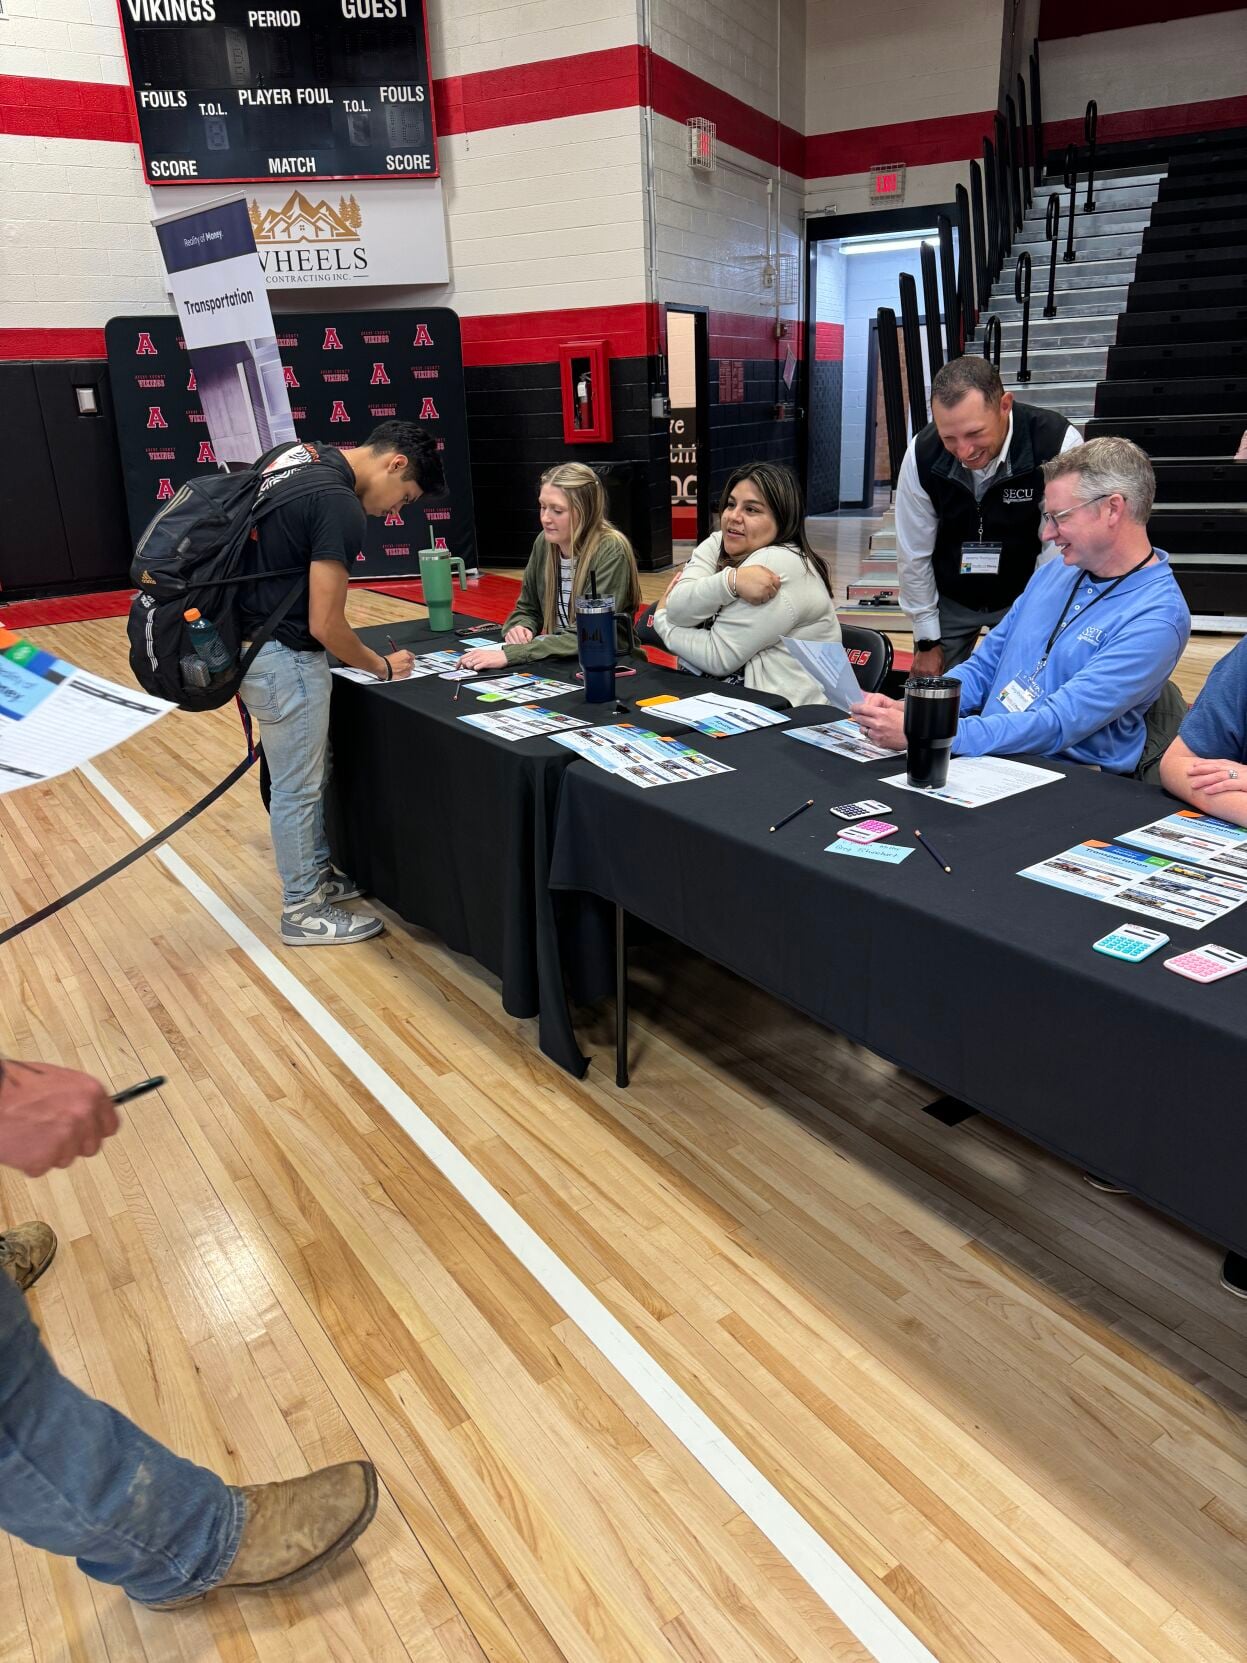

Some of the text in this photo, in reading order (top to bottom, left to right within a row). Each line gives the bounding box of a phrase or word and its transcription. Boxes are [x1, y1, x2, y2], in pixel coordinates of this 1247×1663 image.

[127, 0, 216, 22] VIKINGS
[248, 10, 301, 28] PERIOD
[341, 0, 408, 19] GUEST
[140, 90, 188, 108] FOULS
[238, 87, 334, 106] PLAYER FOUL
[380, 85, 425, 103] FOULS
[199, 103, 228, 116] T.O.L.
[343, 99, 372, 113] T.O.L.
[151, 160, 198, 177] SCORE
[268, 157, 316, 174] MATCH
[386, 154, 431, 171] SCORE
[265, 273, 352, 284] CONTRACTING INC.
[183, 288, 254, 314] Transportation
[136, 332, 158, 355] A
[323, 327, 344, 350] A
[413, 323, 434, 347] A
[370, 362, 391, 385] A
[146, 406, 169, 429] A
[330, 400, 351, 423] A
[419, 397, 440, 419] A
[148, 451, 176, 461] VIKINGS
[196, 441, 217, 463] A
[156, 478, 176, 500] A
[1003, 488, 1034, 499] SECU
